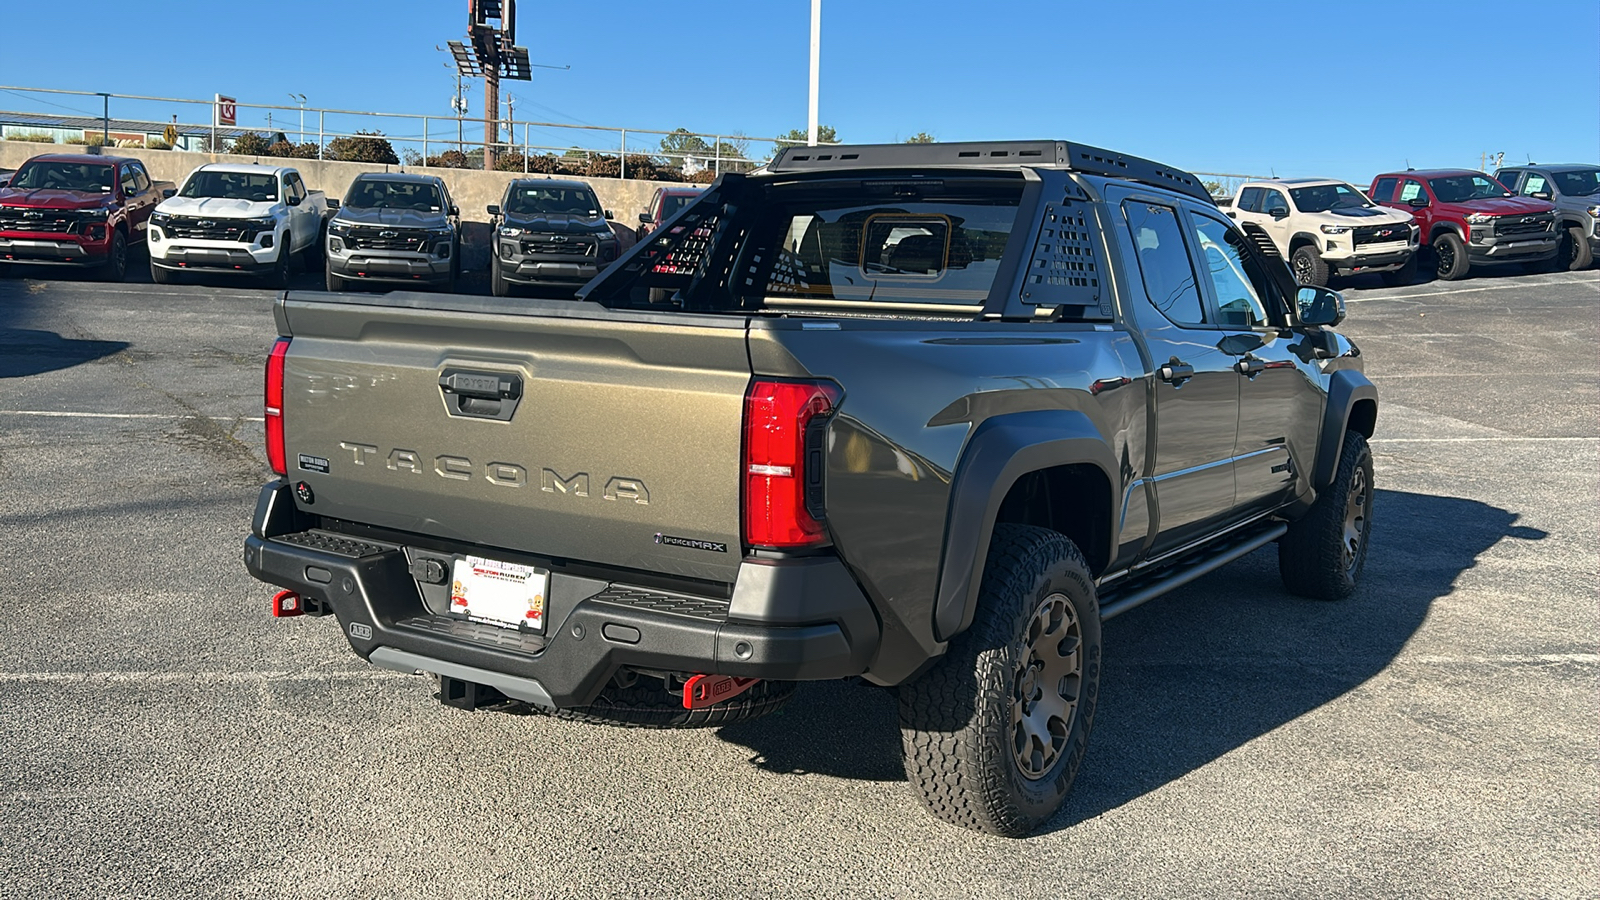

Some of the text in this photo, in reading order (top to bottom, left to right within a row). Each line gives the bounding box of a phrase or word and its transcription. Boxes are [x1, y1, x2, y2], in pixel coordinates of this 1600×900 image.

[457, 377, 497, 391] TOYOTA
[339, 440, 650, 505] TACOMA
[473, 567, 526, 580] MILTON RUBEN
[352, 625, 370, 638] ARB
[715, 681, 732, 695] ARB
[1054, 644, 1100, 795] GOODYEAR
